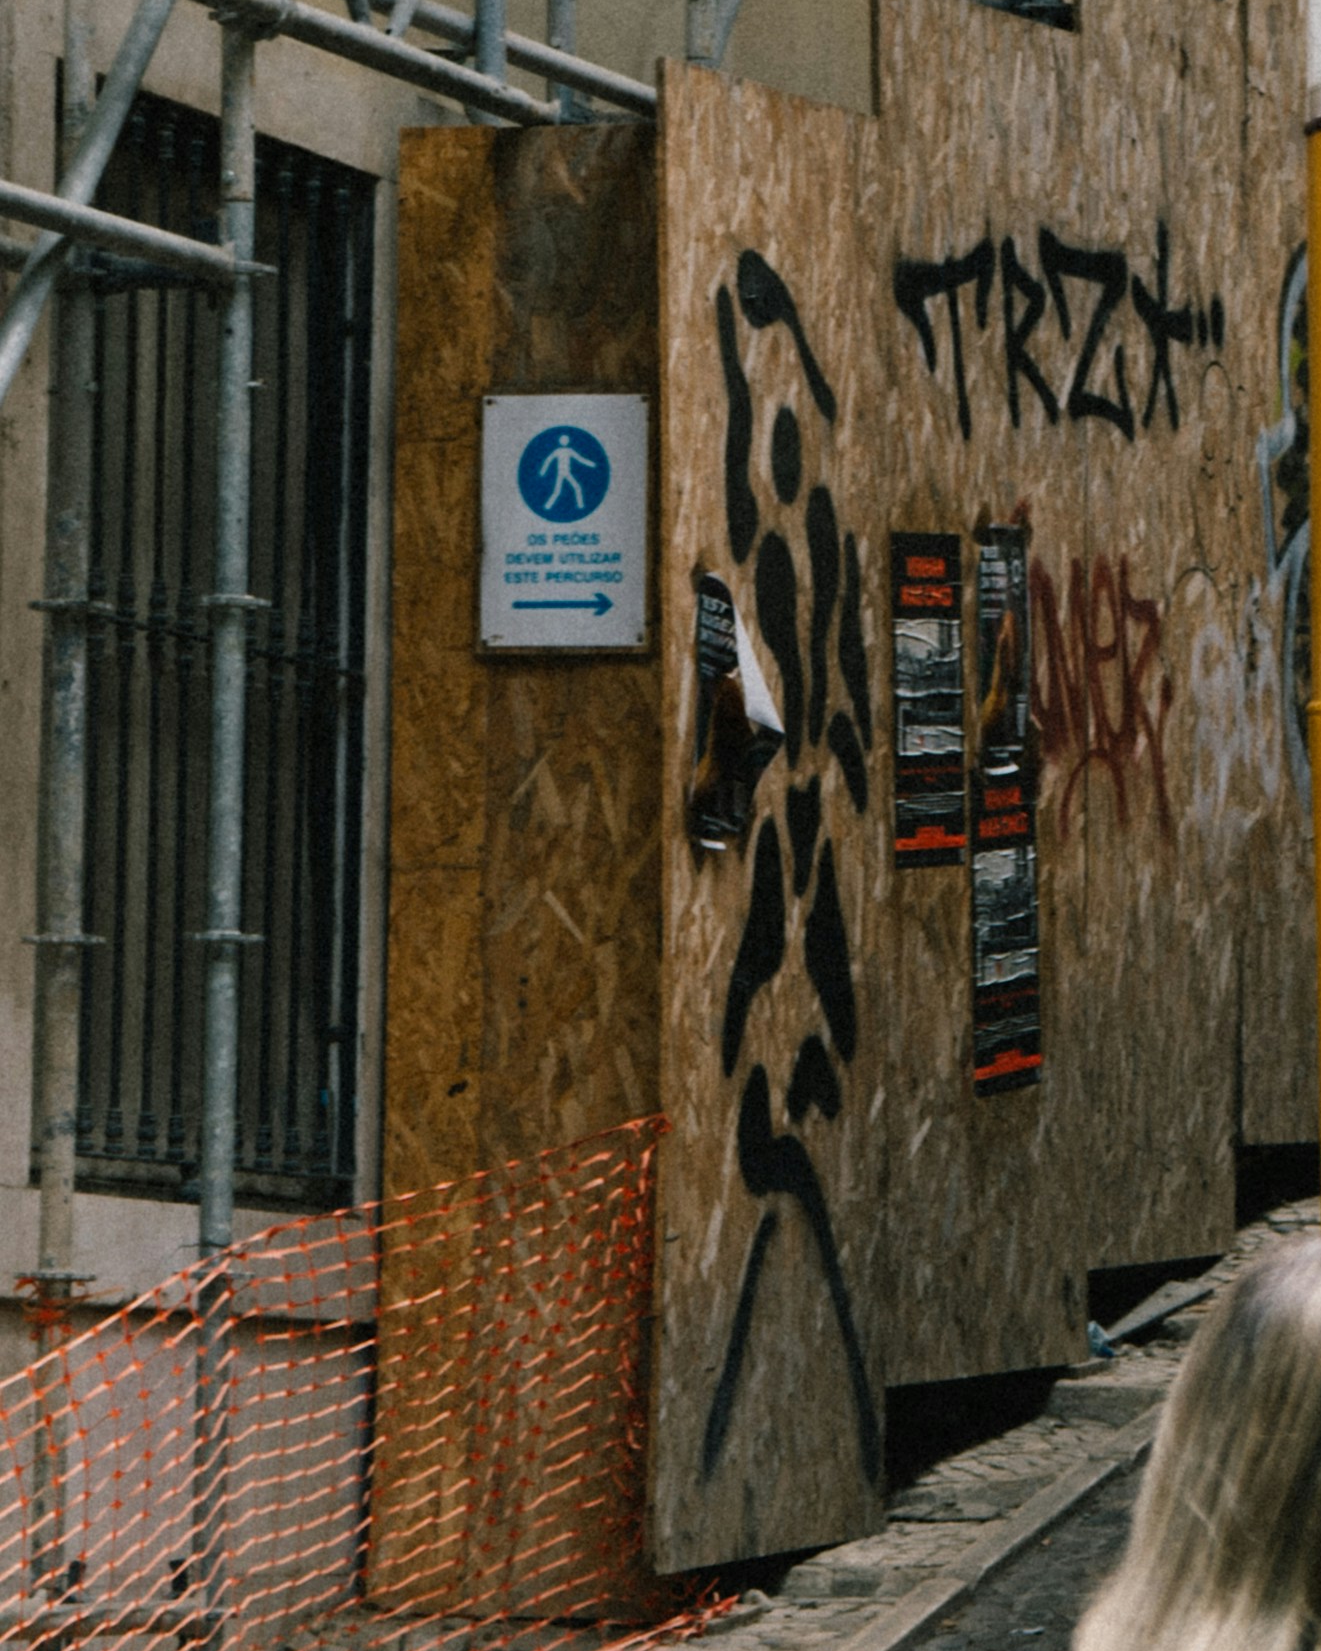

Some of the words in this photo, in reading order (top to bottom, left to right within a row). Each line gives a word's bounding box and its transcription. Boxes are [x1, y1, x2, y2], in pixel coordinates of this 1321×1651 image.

[528, 533, 547, 546] OS
[506, 552, 553, 564] DEVEM
[560, 552, 621, 564] UTILIZAR
[504, 571, 539, 584] ESTE
[545, 570, 623, 583] PERCURSO
